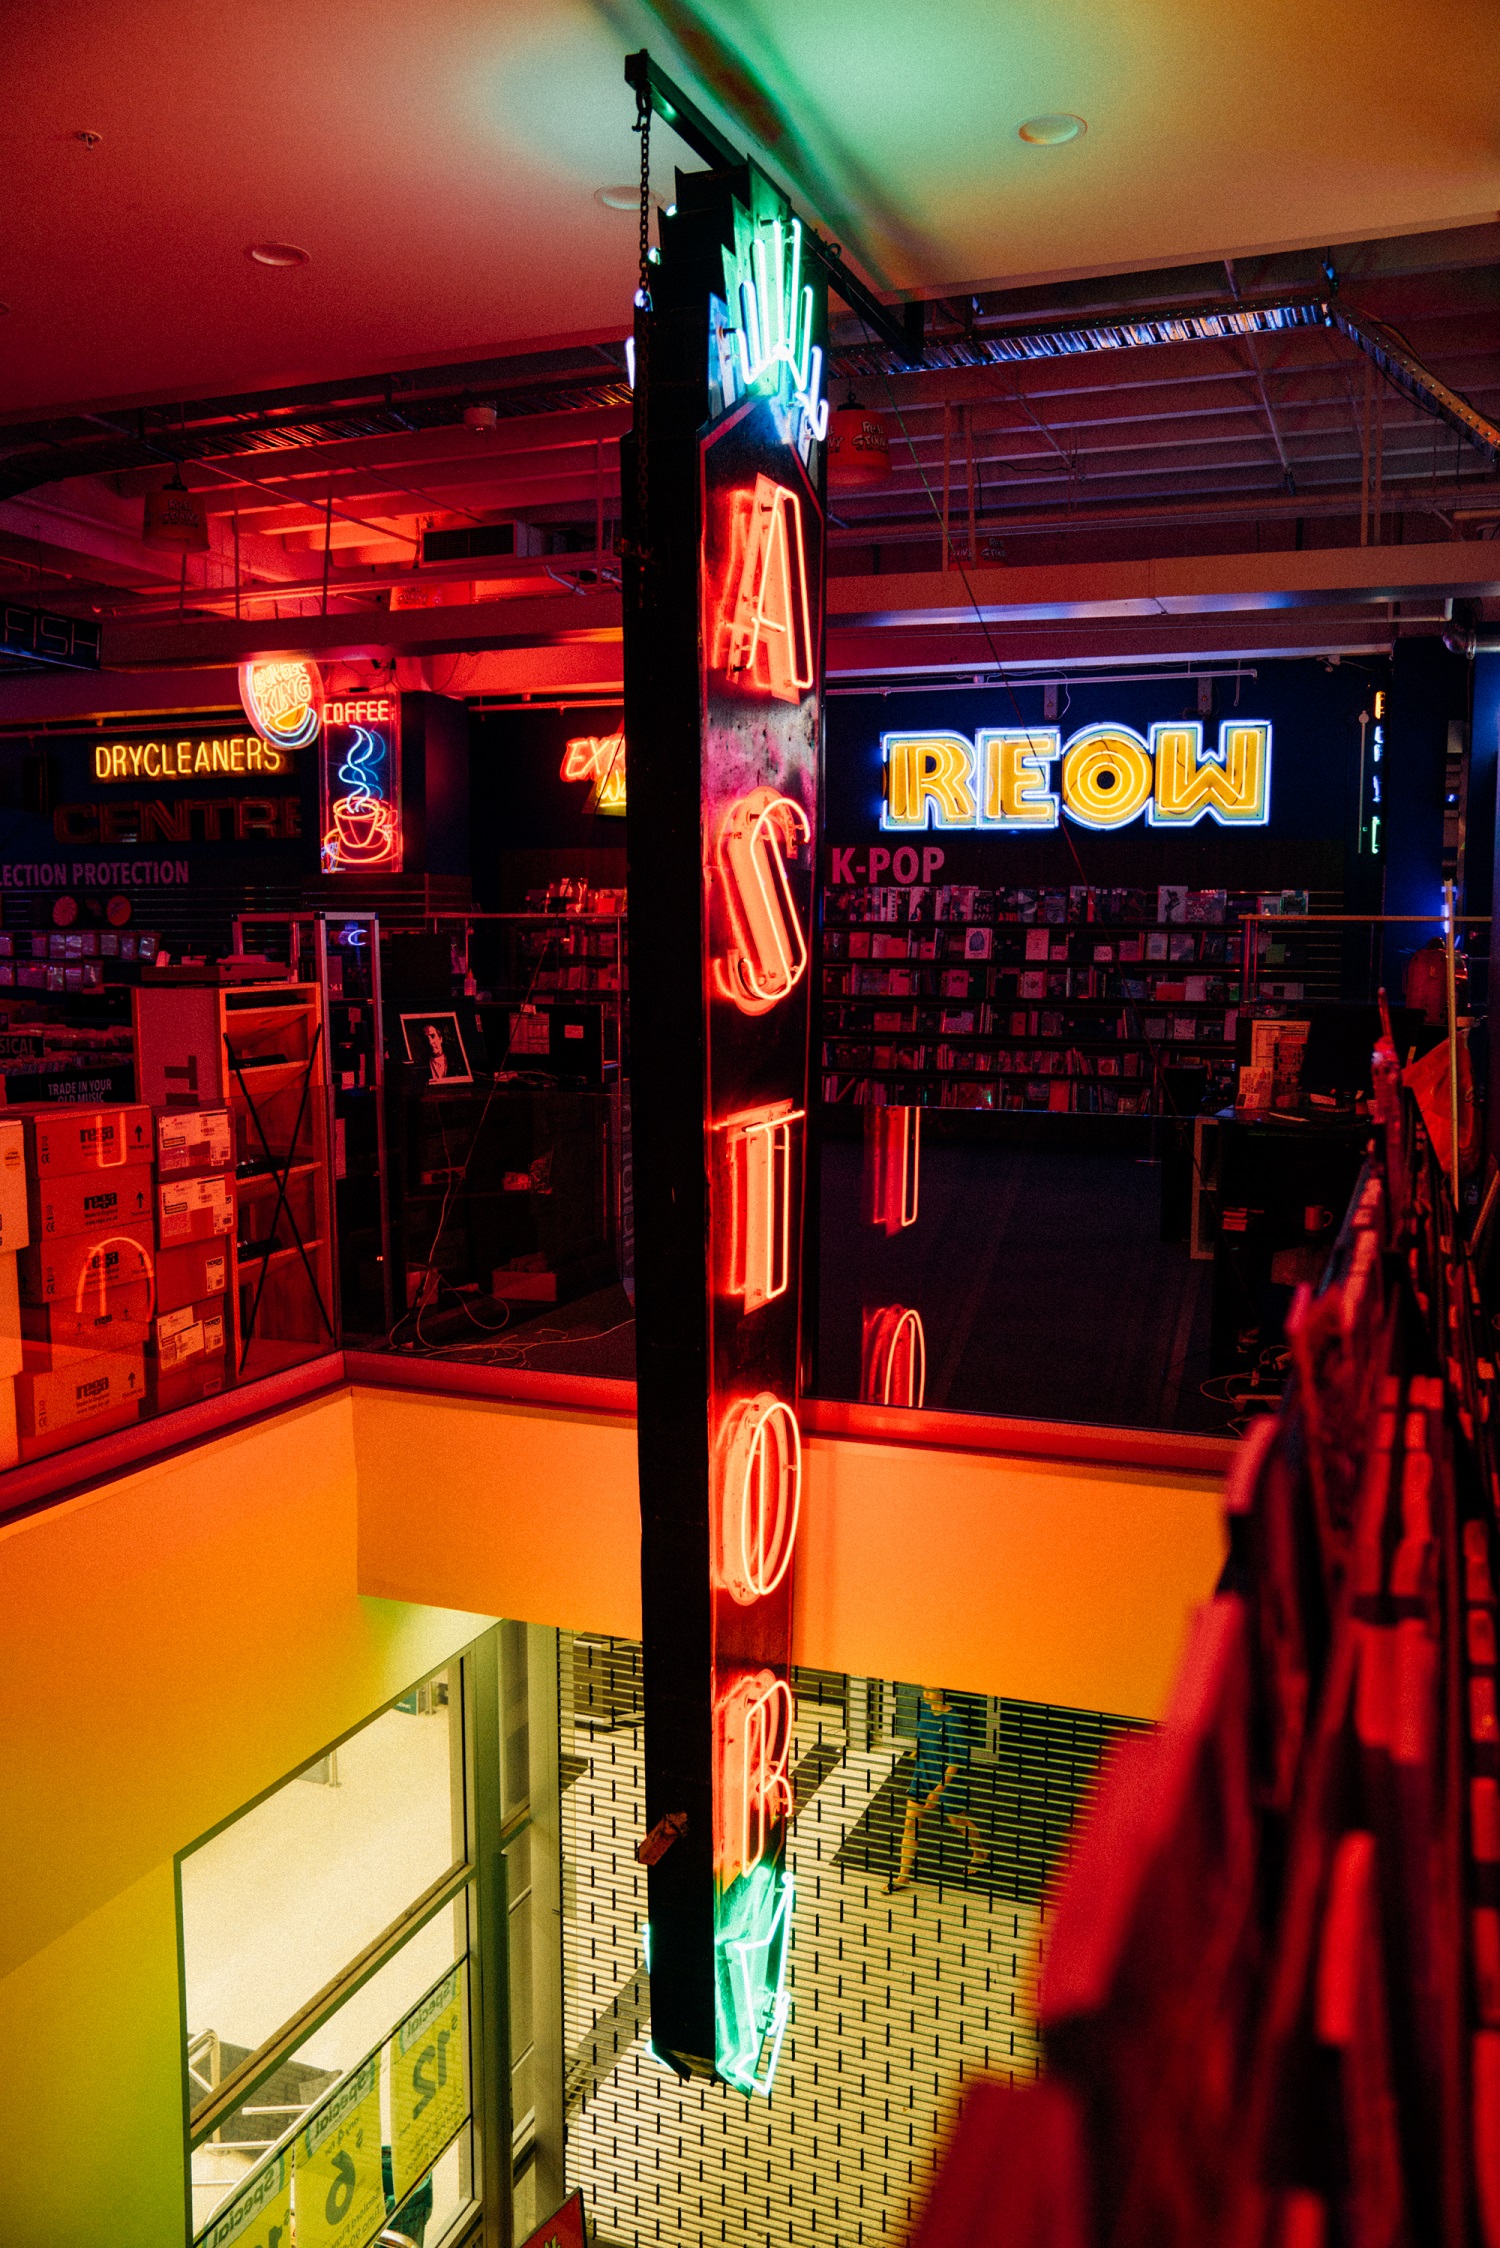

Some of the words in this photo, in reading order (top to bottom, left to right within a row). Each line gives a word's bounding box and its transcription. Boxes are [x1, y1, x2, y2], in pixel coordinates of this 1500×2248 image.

[4, 606, 100, 662] FISH
[254, 662, 307, 693] BURGER
[255, 674, 312, 723] KING
[322, 699, 391, 725] COFFEE
[94, 736, 282, 779] DRYCLEANERS
[879, 719, 1272, 832] REOW
[0, 863, 67, 888] ECTION
[72, 860, 189, 886] PROTECTION
[831, 846, 945, 885] K-POP
[48, 1082, 77, 1096] TRADE
[78, 1081, 88, 1093] IN
[88, 1078, 112, 1092] YOUR
[77, 1092, 105, 1103] MUSIC
[84, 1192, 118, 1210] rega
[76, 1377, 109, 1399] rega
